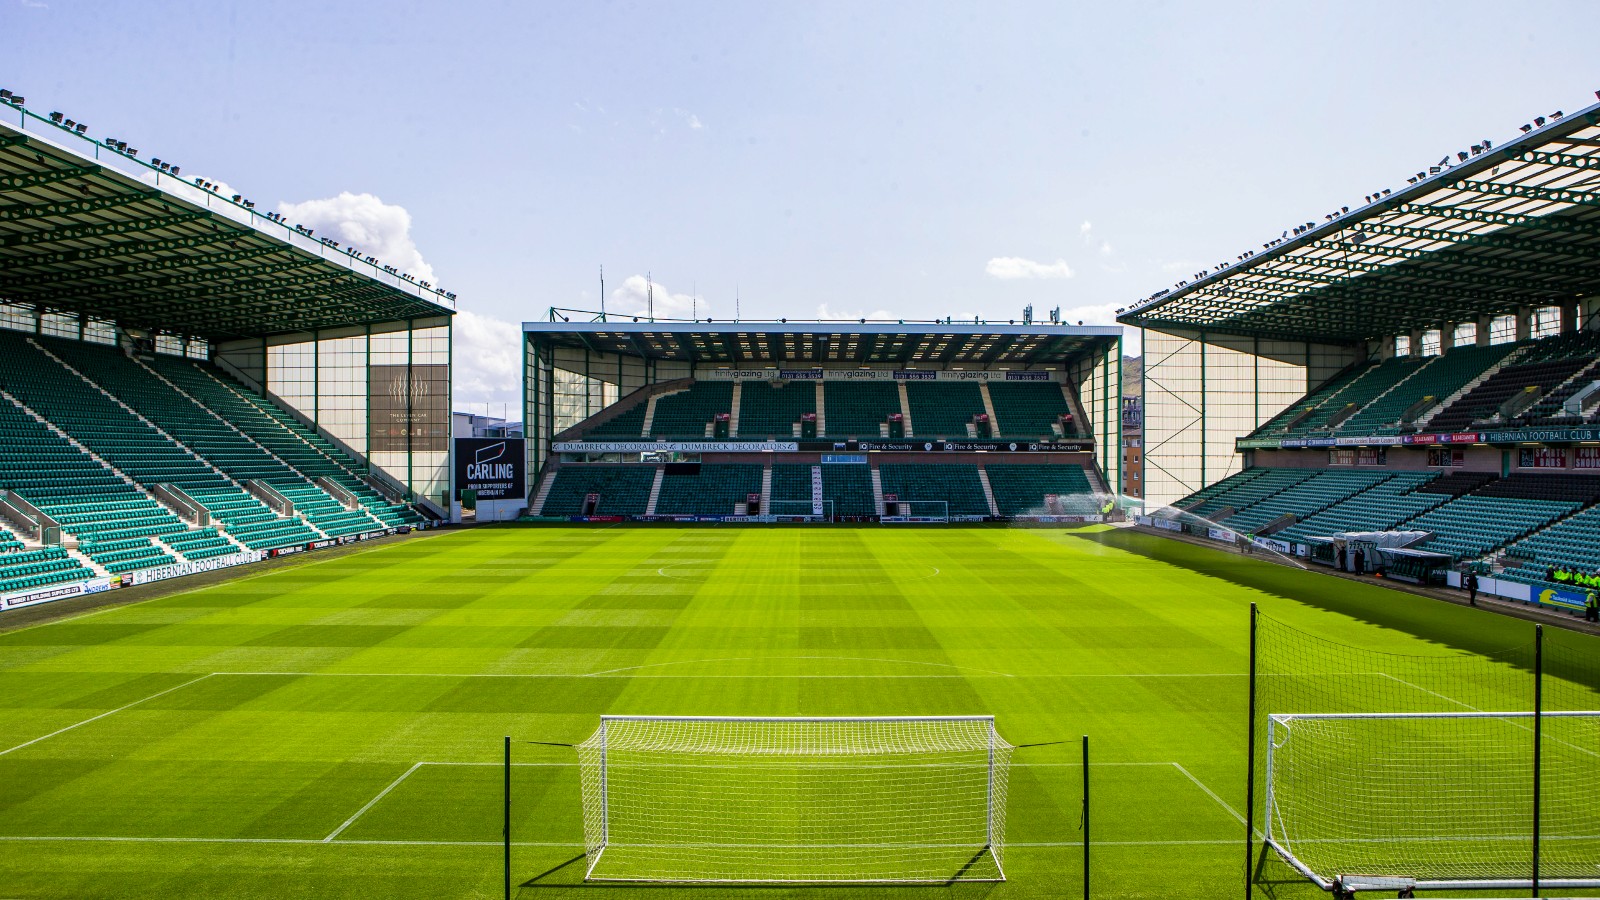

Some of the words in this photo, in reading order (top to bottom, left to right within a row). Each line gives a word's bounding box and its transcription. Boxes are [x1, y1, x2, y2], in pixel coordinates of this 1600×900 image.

[1490, 433, 1526, 442] HIBERNIAN
[1530, 432, 1567, 440] FOOTBALL
[1570, 430, 1592, 440] CLUB
[1536, 449, 1566, 457] SPORTS
[1580, 448, 1598, 457] POOL
[1540, 458, 1560, 466] BARS
[467, 464, 513, 479] CARLING
[146, 563, 193, 582] HIBERNIAN
[196, 556, 233, 572] FOOTBALL
[236, 553, 253, 564] CLUB
[9, 596, 26, 605] TIMBER
[31, 592, 51, 600] BUILDING
[52, 588, 71, 596] SUPPLIES
